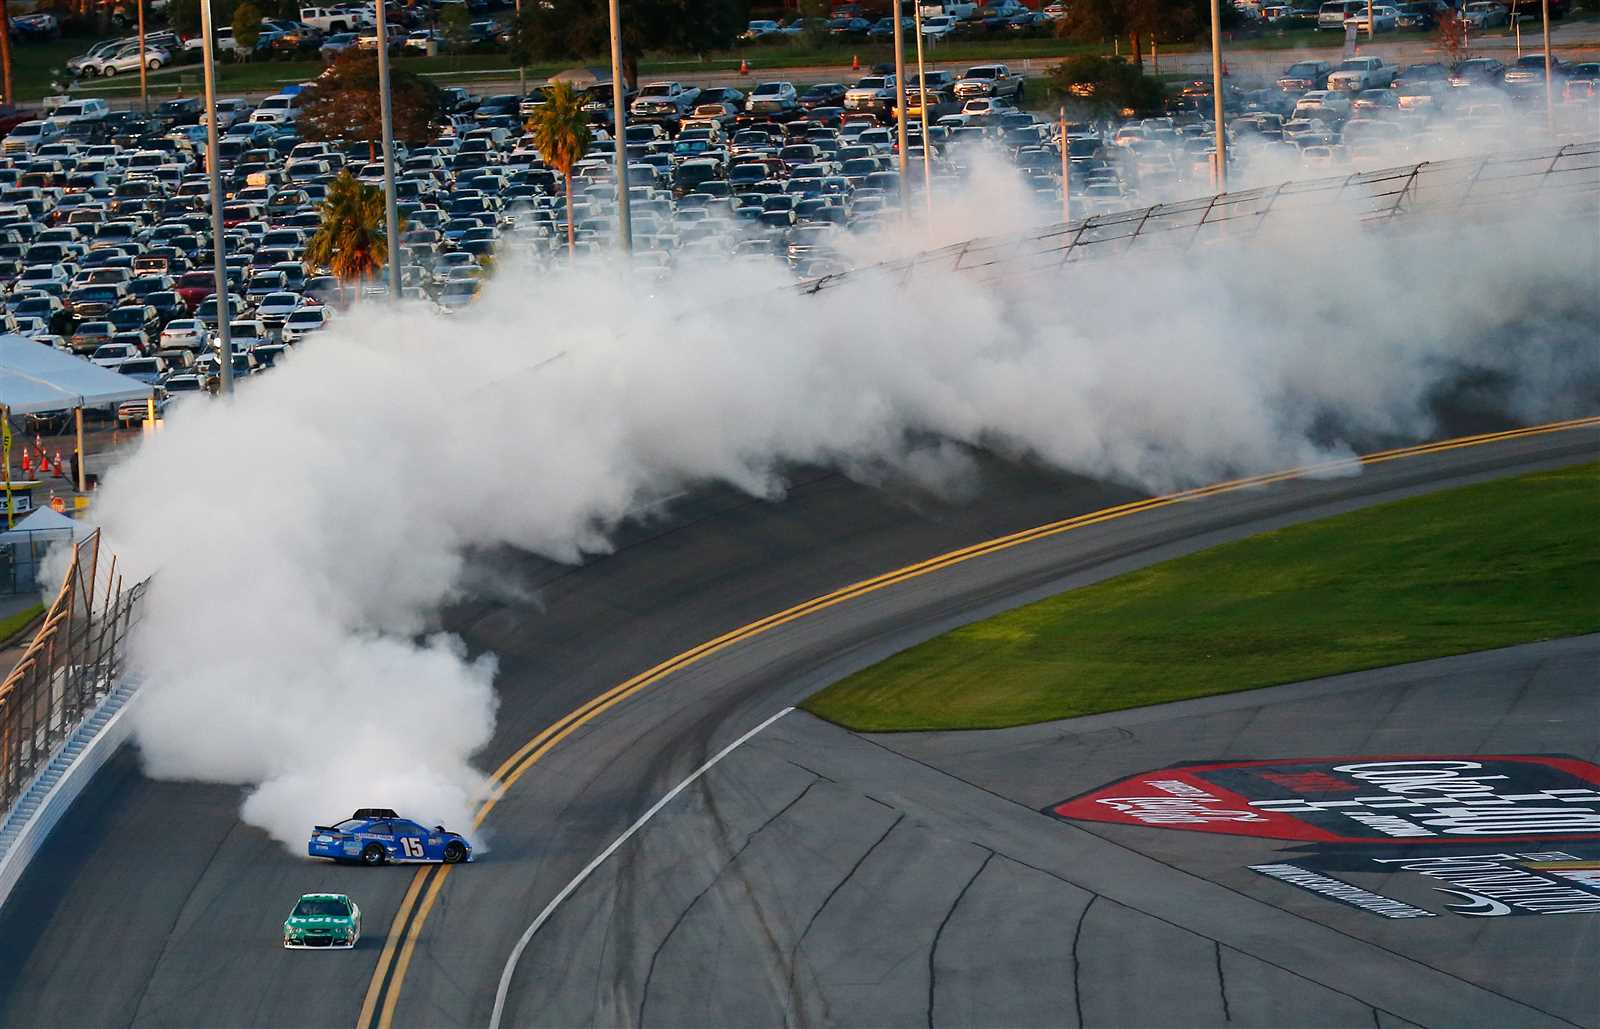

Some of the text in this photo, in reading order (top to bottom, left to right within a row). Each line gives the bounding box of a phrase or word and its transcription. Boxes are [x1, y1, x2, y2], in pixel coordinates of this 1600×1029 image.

[1332, 760, 1509, 794] Coke
[1410, 807, 1600, 834] 400
[400, 836, 425, 857] 15
[1372, 853, 1600, 914] FOUNDATION
